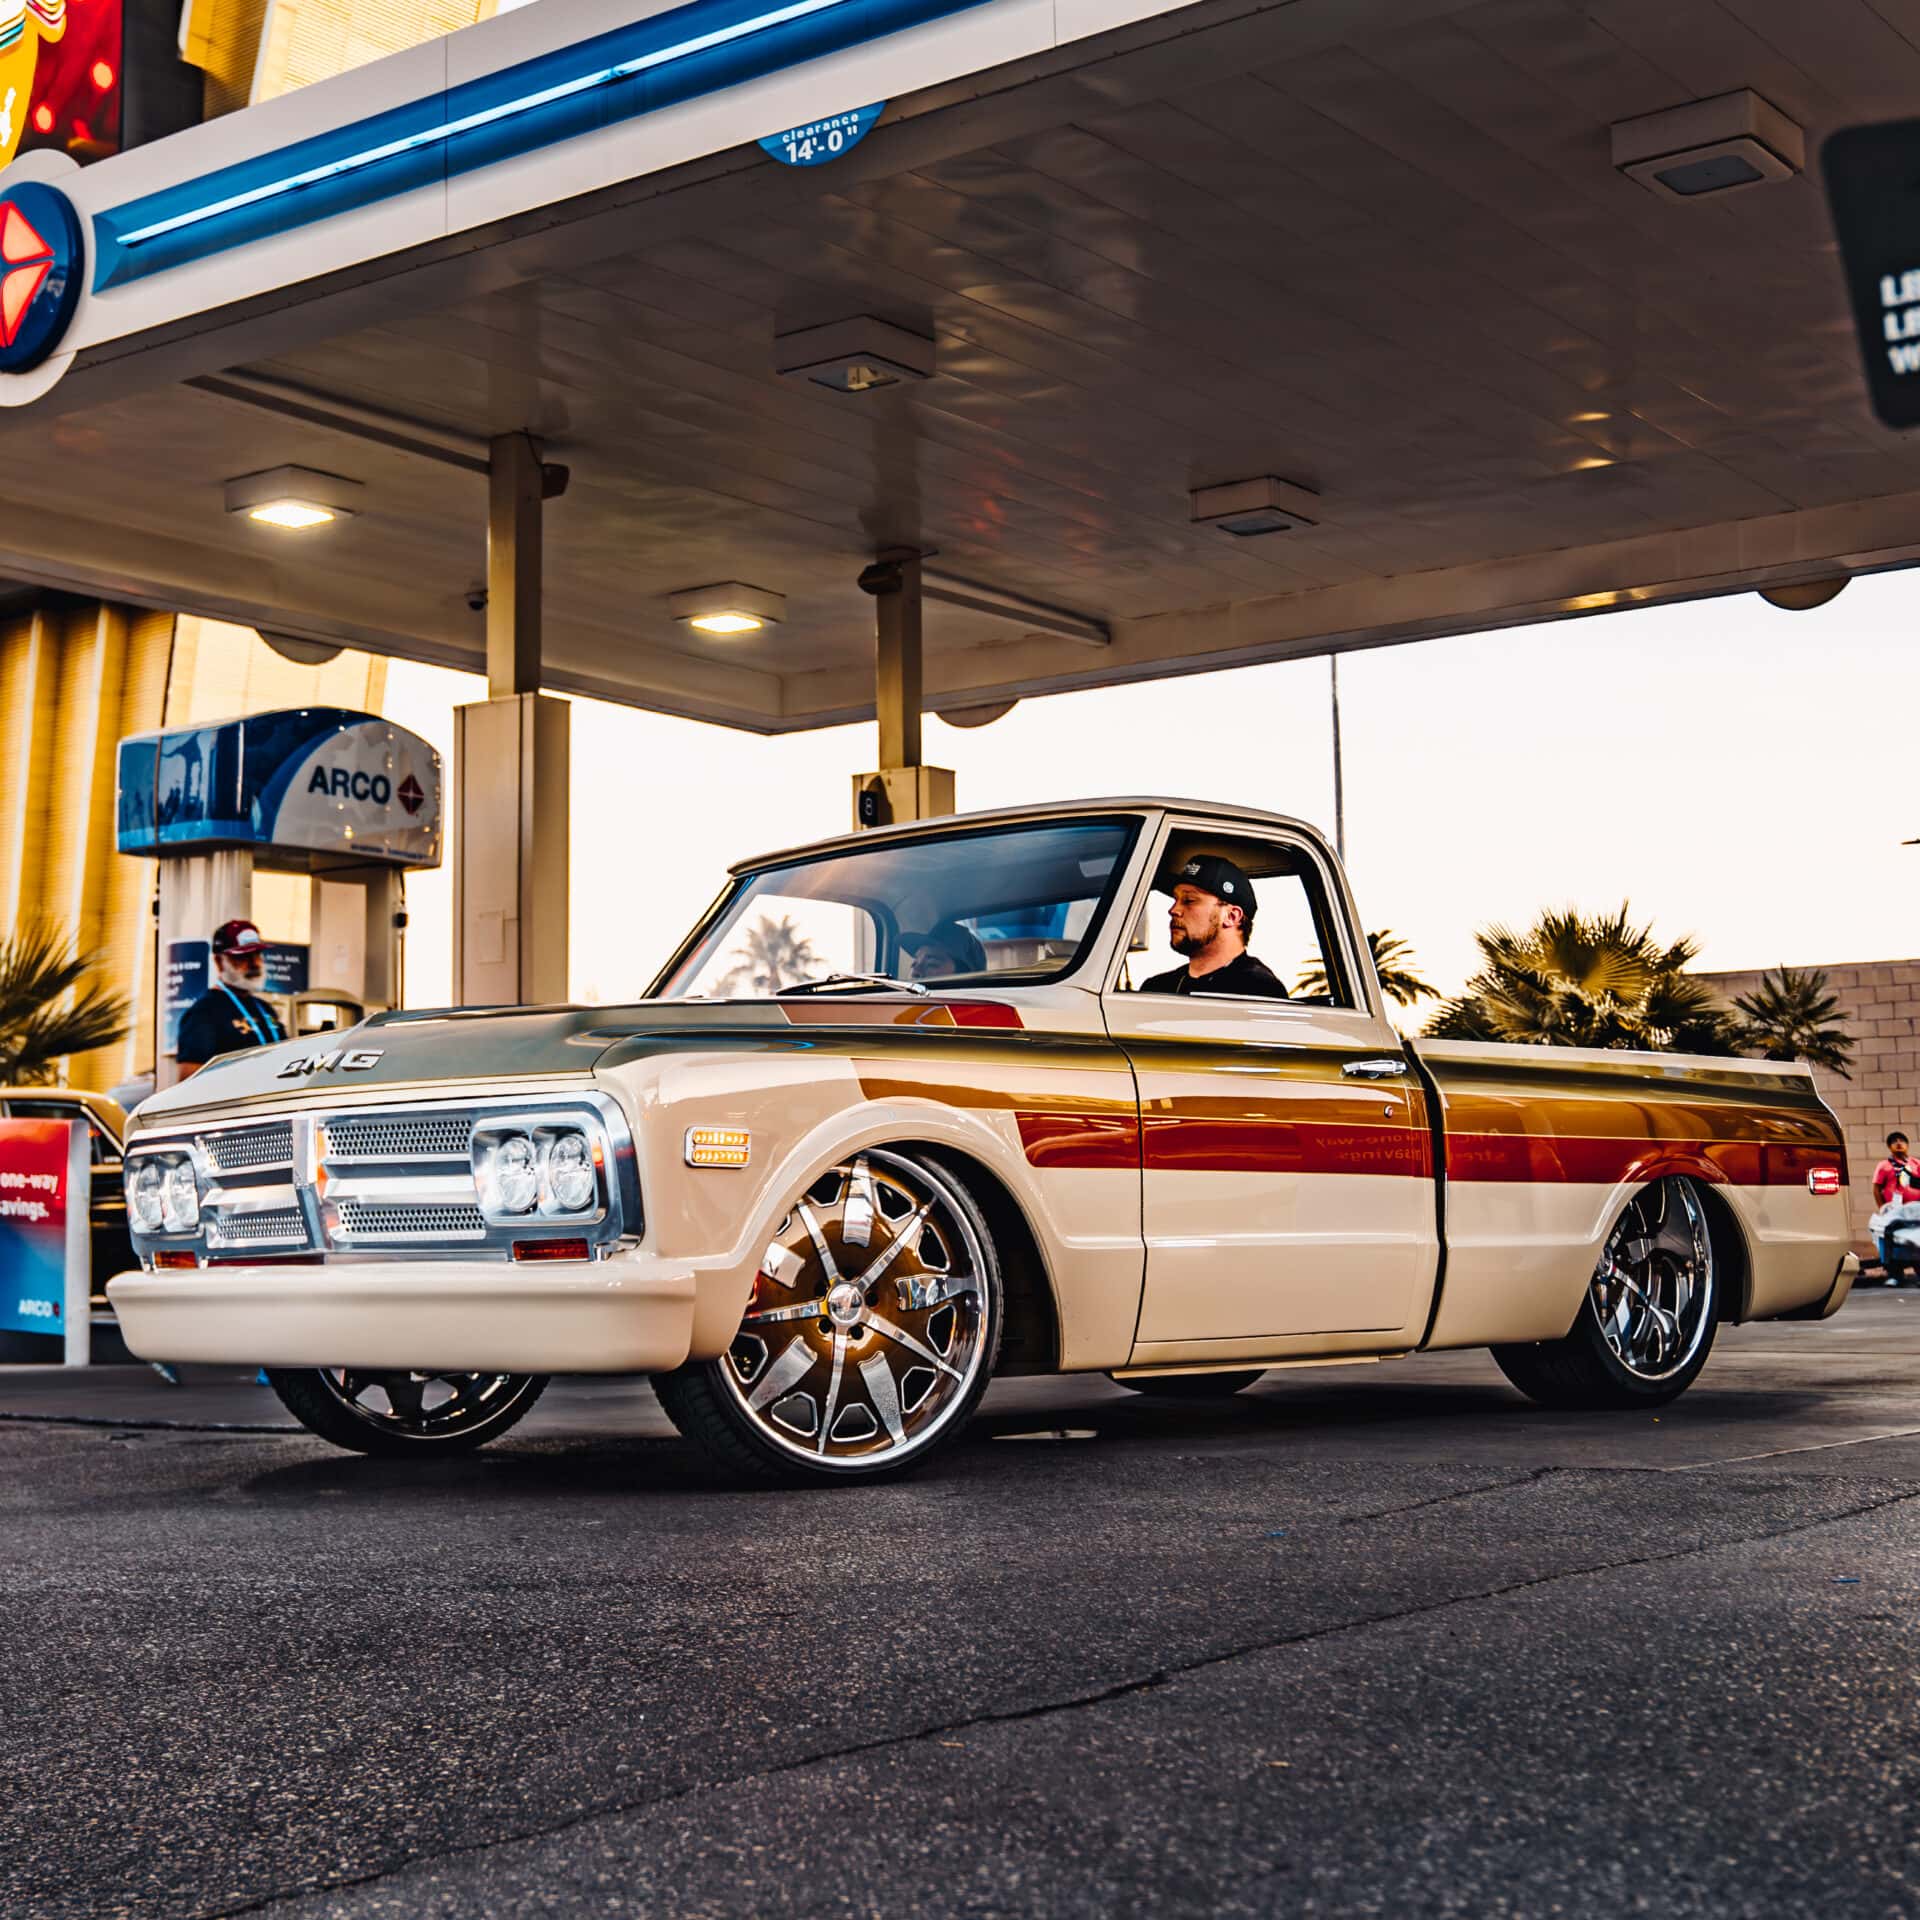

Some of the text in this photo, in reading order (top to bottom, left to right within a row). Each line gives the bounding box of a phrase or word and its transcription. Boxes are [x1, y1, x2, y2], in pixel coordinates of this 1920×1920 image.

[781, 113, 859, 143] clearance
[307, 764, 391, 805] ARCO
[0, 1172, 58, 1194] one-way
[18, 1299, 53, 1317] ARCO
